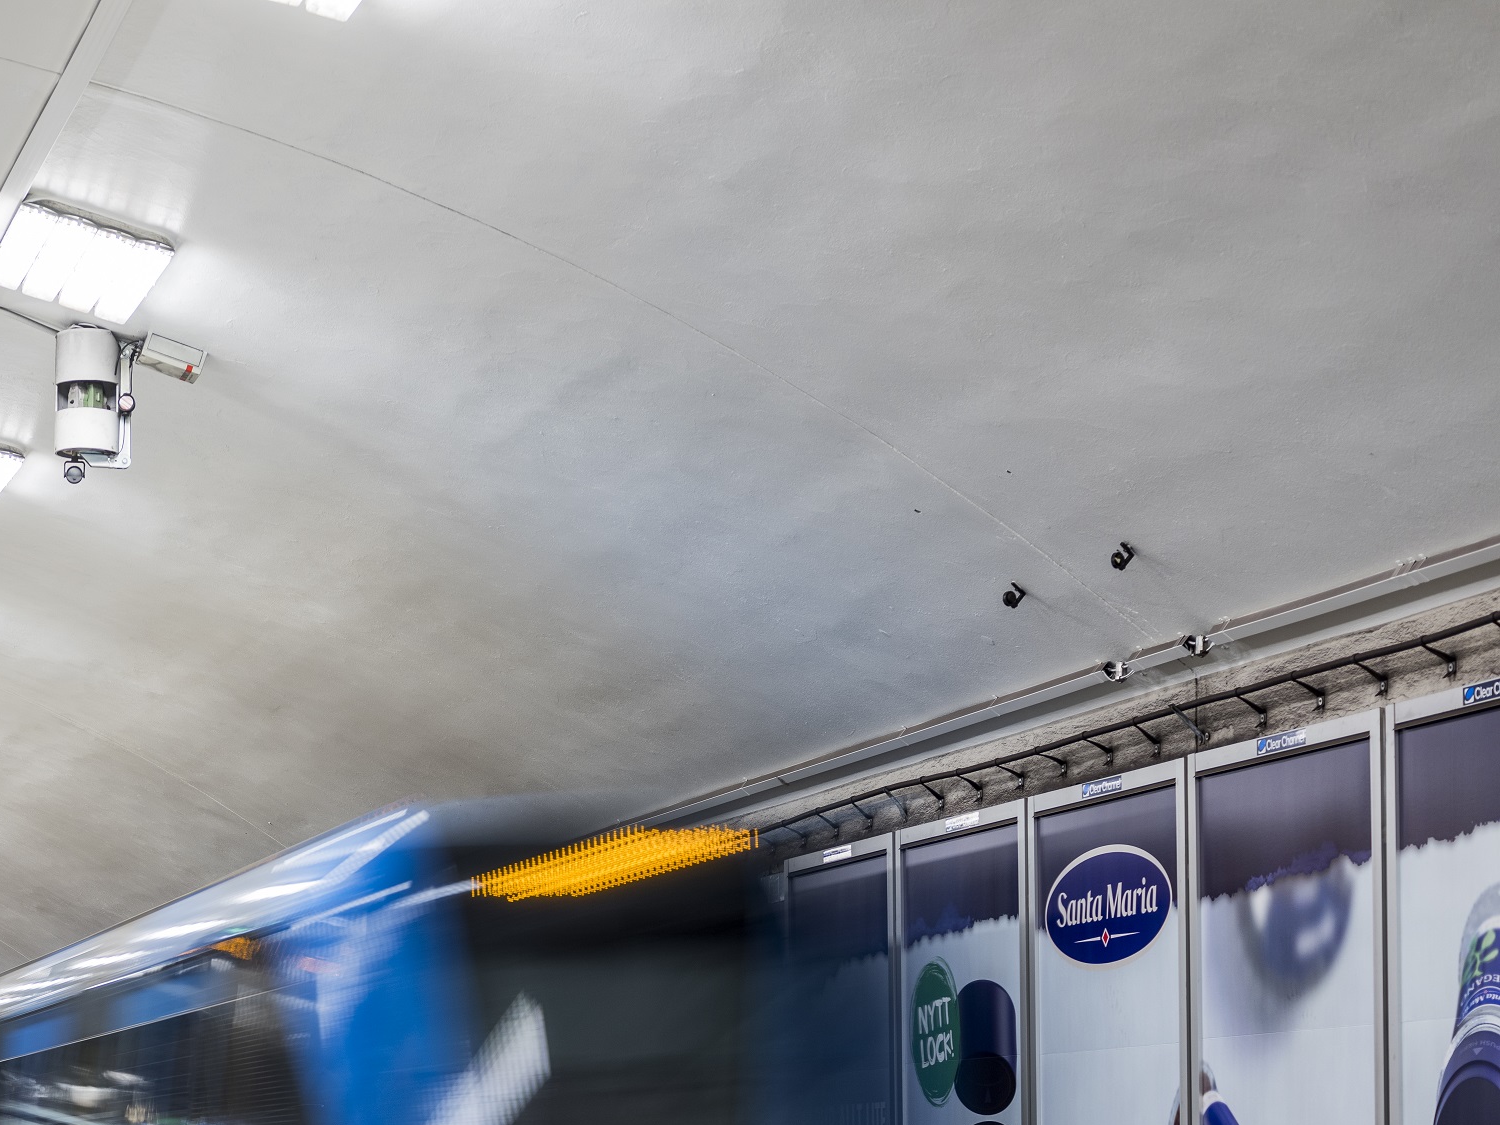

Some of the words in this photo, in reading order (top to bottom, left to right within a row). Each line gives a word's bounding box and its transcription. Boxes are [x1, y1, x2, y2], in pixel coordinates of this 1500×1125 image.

[1474, 686, 1493, 700] Clear
[1266, 738, 1282, 751] Clear
[1057, 890, 1104, 928] Santa
[1105, 876, 1159, 920] Maria
[918, 996, 952, 1034] NYTT
[920, 1030, 955, 1069] LOCK!
